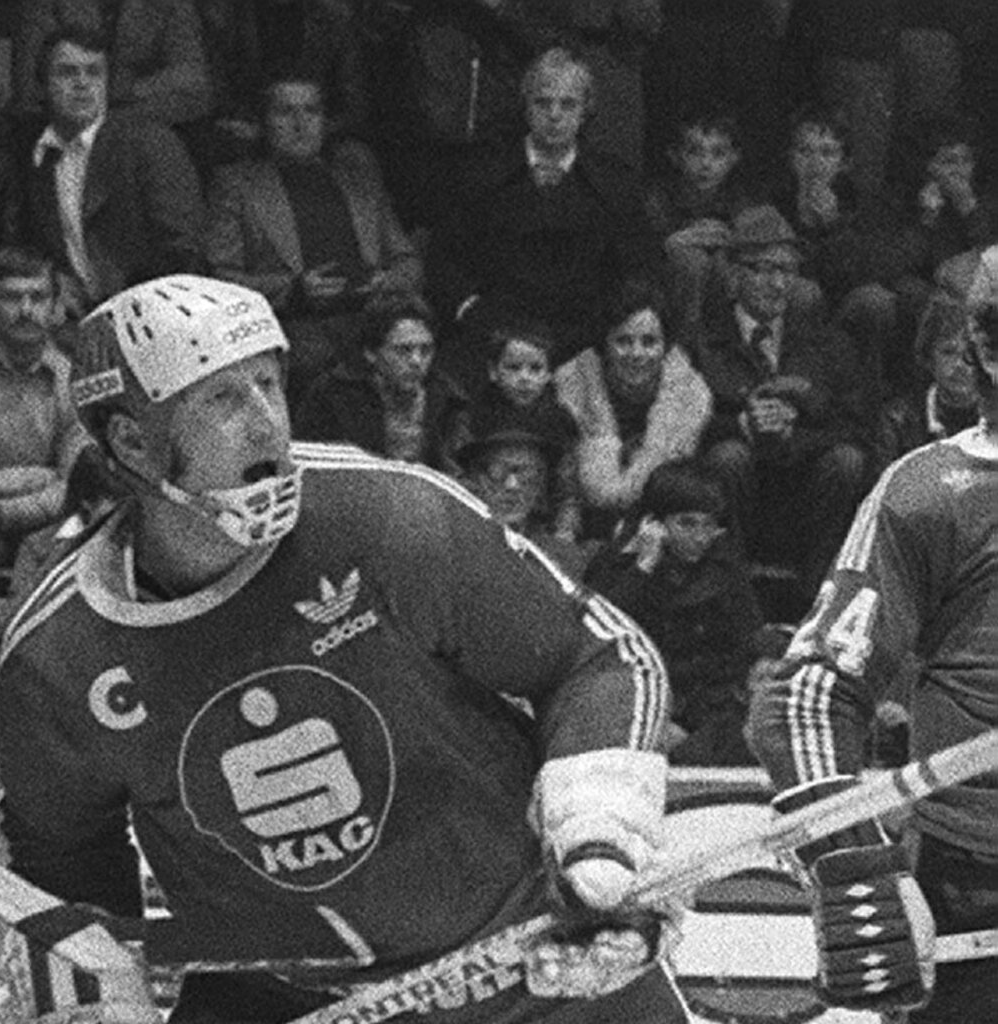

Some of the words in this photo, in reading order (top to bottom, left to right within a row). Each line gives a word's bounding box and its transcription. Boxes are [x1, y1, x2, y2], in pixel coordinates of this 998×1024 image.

[312, 610, 378, 656] adidas
[88, 666, 148, 730] C
[260, 815, 375, 873] KAC
